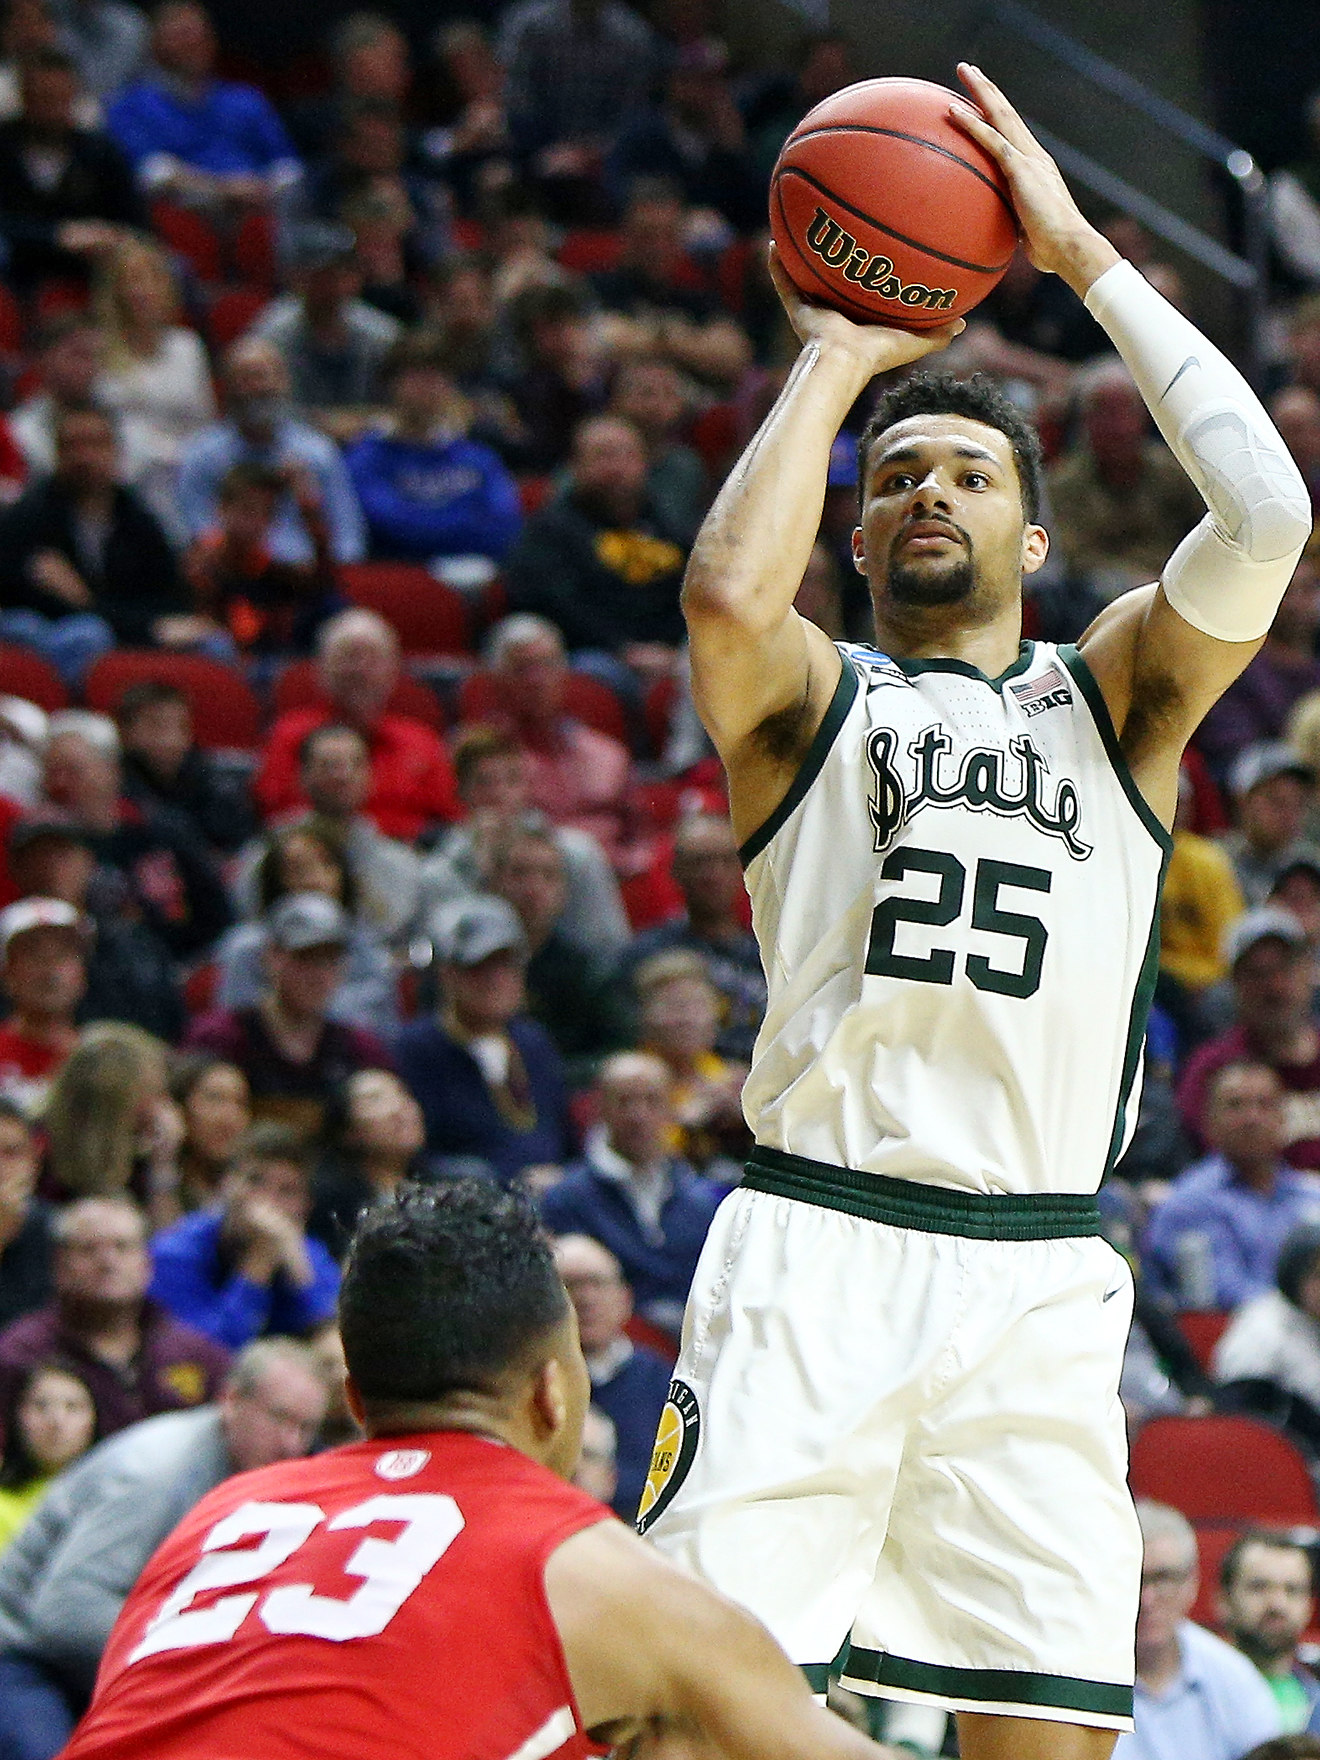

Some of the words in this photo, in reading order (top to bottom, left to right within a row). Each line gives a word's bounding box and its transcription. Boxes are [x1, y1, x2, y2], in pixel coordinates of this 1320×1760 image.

[806, 206, 958, 310] Wilson
[866, 723, 1094, 861] State
[864, 846, 1053, 1000] 25
[128, 1493, 466, 1666] 23
